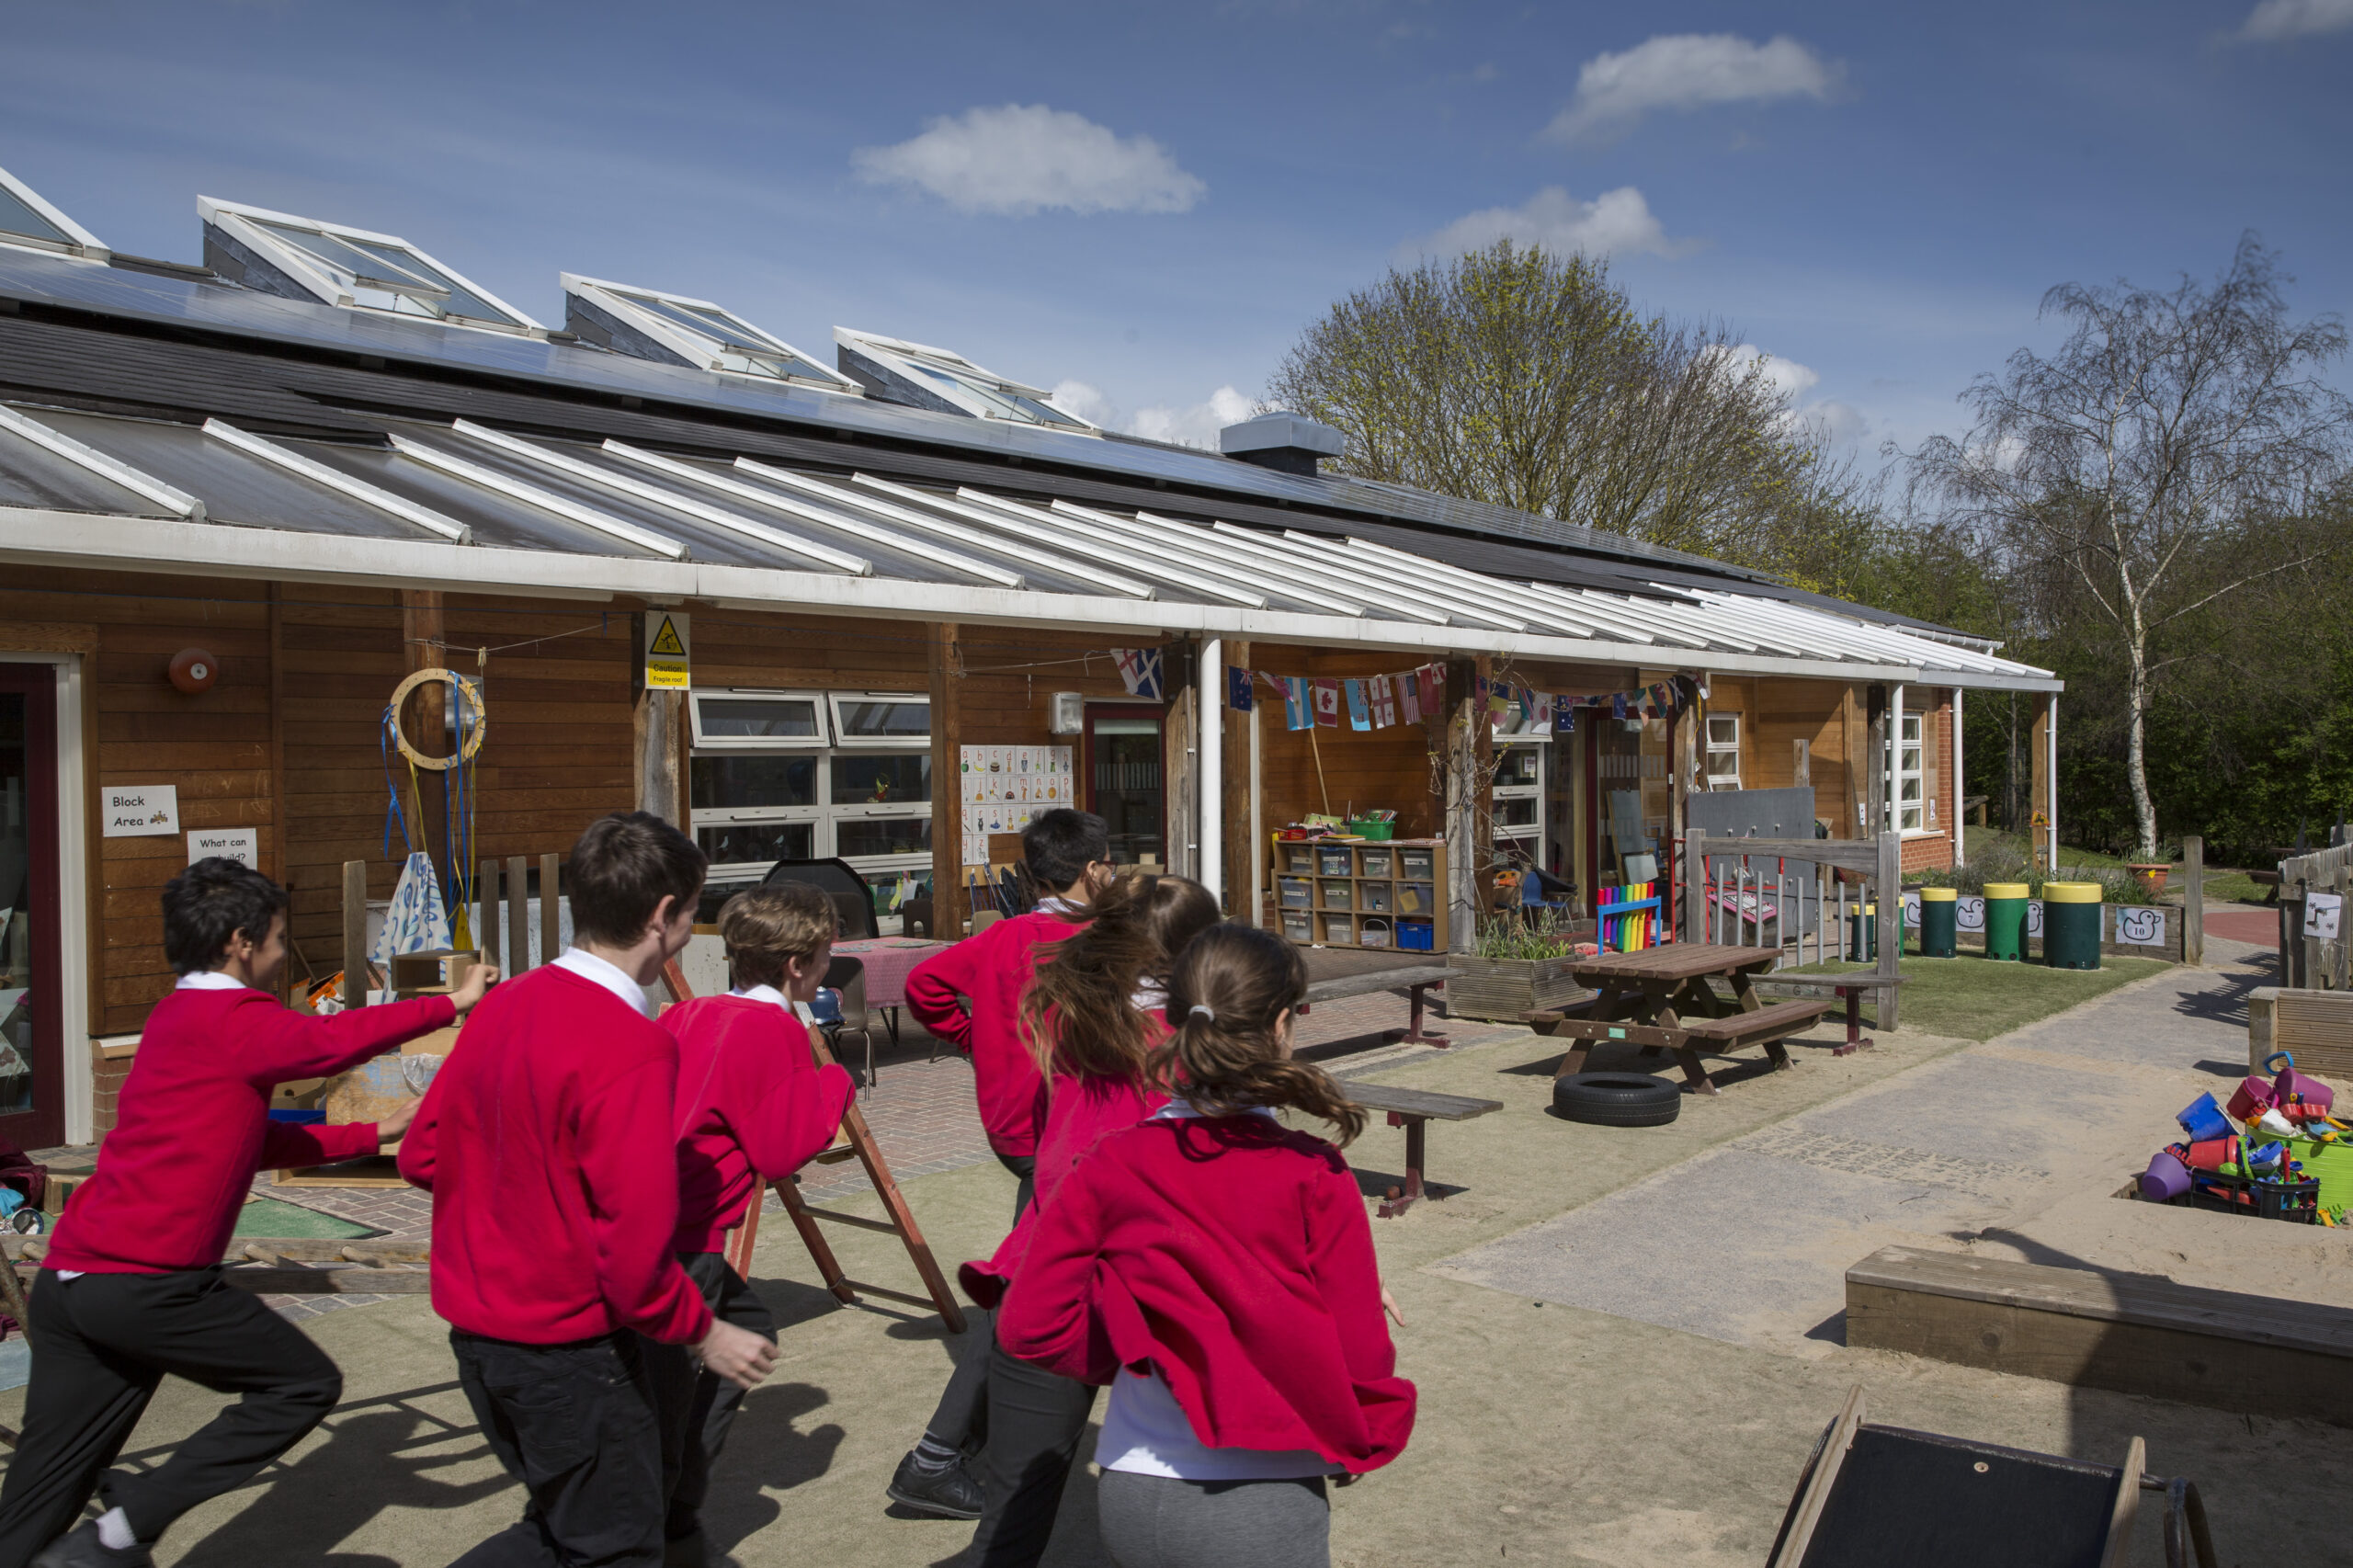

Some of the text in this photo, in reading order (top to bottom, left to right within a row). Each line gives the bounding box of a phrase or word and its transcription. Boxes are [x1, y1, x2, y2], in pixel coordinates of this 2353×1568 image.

[654, 664, 682, 672] Caution
[962, 750, 968, 758] a
[977, 749, 983, 761] b
[1006, 750, 1012, 760] d
[1022, 751, 1028, 759] e
[1036, 749, 1040, 763] f
[1051, 749, 1056, 760] g
[1063, 750, 1068, 761] h
[978, 778, 982, 792] j
[993, 778, 997, 789] k
[1063, 778, 1068, 790] p
[113, 796, 144, 807] Block
[961, 810, 968, 821] q
[993, 809, 997, 817] s
[1008, 809, 1013, 818] t
[114, 817, 143, 826] Area
[199, 838, 226, 847] What
[962, 838, 968, 850] y
[1755, 983, 1760, 993] E
[1793, 985, 1801, 995] G
[1813, 987, 1820, 997] A
